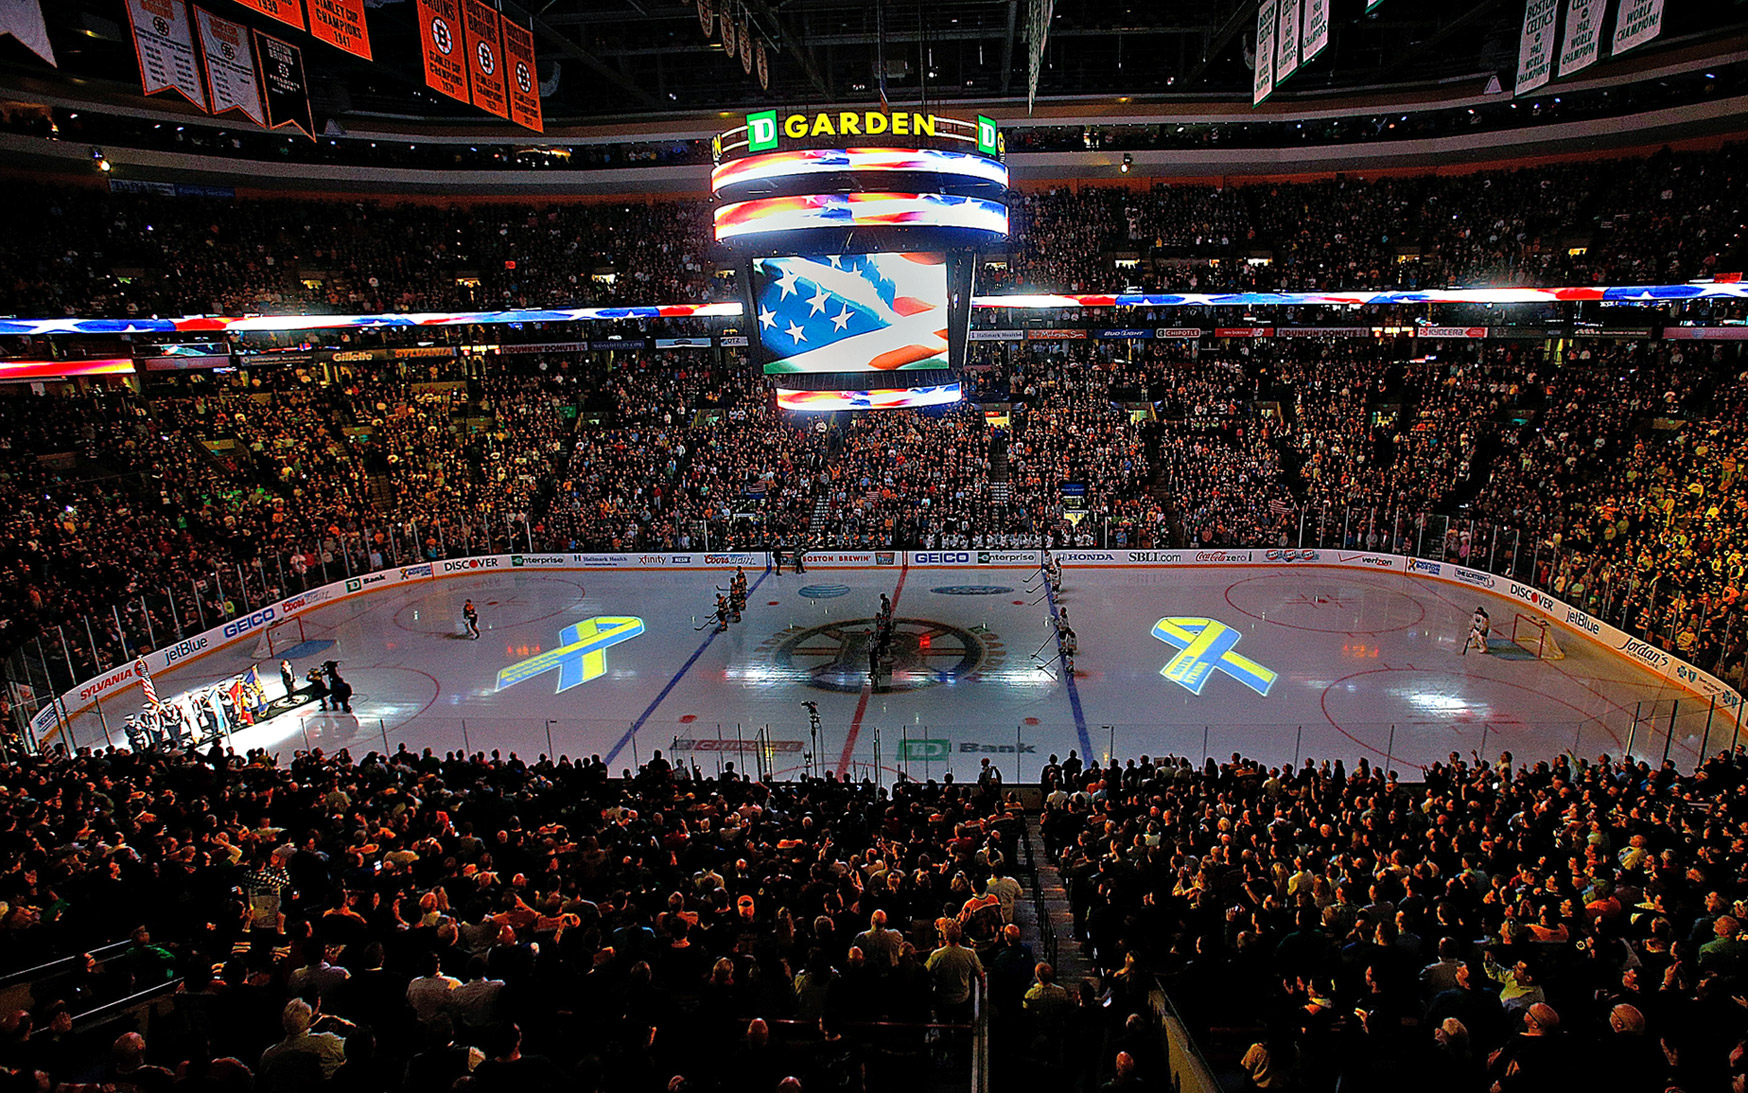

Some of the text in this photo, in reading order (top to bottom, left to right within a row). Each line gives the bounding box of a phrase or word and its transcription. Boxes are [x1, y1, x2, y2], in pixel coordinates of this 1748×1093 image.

[315, 9, 362, 39] CHAMPIONS
[1526, 8, 1554, 35] CELTICS
[333, 31, 351, 48] 1941
[1571, 29, 1594, 49] WORLD
[1526, 53, 1545, 70] WORLD
[1517, 62, 1550, 84] CHAMPIONS
[750, 112, 936, 144] TD GARDEN
[976, 331, 1000, 339] Hallmark
[1040, 330, 1084, 340] Mohegan Sun
[1284, 328, 1357, 337] DUNKIN' DONUTS
[1428, 328, 1463, 336] KYOCERA
[332, 352, 373, 362] Gillette
[395, 346, 451, 358] SYLVANIA
[639, 554, 667, 565] xfinity
[704, 554, 729, 564] Coors
[915, 552, 969, 564] GEICO
[1067, 553, 1115, 561] HONDA
[1128, 552, 1182, 562] SBLI.com
[1225, 554, 1247, 562] zero
[1361, 556, 1393, 566] verizon
[444, 558, 498, 572] DISCOVER
[363, 574, 386, 584] Bank
[1466, 571, 1487, 582] LOTTERY
[1510, 583, 1554, 612] DISCOVER
[282, 598, 306, 613] Coors
[223, 608, 275, 638] GEICO
[1566, 608, 1600, 635] jetBlue
[163, 637, 208, 666] jetBlue
[1613, 637, 1669, 667] Jordan's
[1626, 651, 1659, 670] FURNITURE
[80, 668, 133, 700] SYLVANIA
[906, 742, 1036, 756] TD Bank
